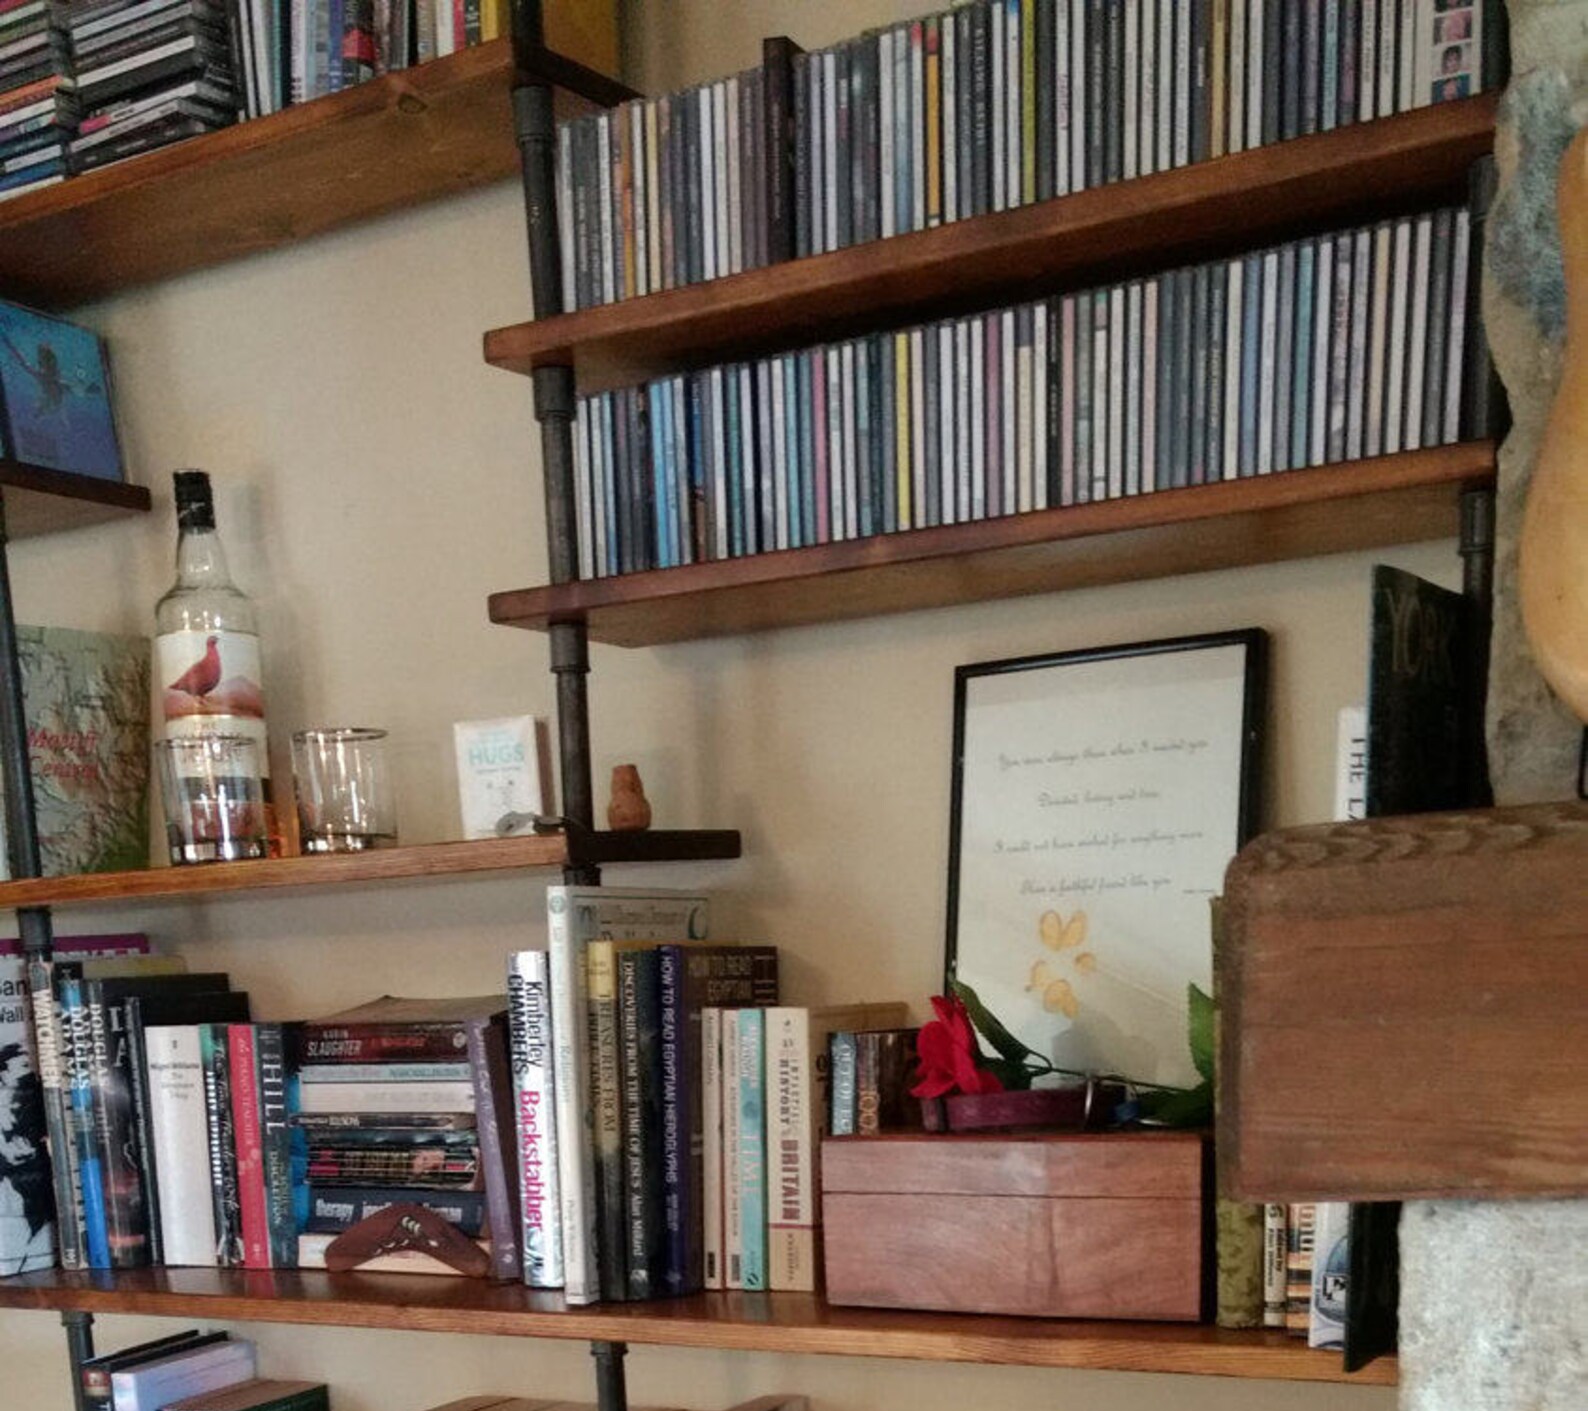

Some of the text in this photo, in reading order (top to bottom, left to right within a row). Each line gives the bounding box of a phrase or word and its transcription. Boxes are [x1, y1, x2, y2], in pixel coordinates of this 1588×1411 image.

[622, 961, 638, 1039] DISCOVERIES
[660, 957, 674, 985] HOW
[662, 988, 675, 1004] TO
[33, 989, 60, 1088] WATCHMEN
[70, 1006, 90, 1089] DOUGLAS
[90, 1003, 109, 1088] DOUGLAS
[308, 1040, 362, 1056] SLAUGHTER
[507, 975, 529, 1084] CHAMBERS
[524, 981, 546, 1068] Kimberley
[663, 1008, 676, 1040] READ
[626, 1042, 639, 1076] FROM
[663, 1043, 677, 1101] EGYPTIAN
[262, 1062, 286, 1136] HILL
[627, 1079, 640, 1104] THE
[628, 1107, 641, 1135] TIME
[779, 1059, 791, 1125] HISTORY
[520, 1090, 544, 1231] Backstabber
[630, 1138, 642, 1153] OF
[630, 1156, 643, 1188] JESUS
[664, 1104, 678, 1183] HIEROGLYPHS
[315, 1198, 354, 1221] therapy
[781, 1139, 800, 1221] BRITAIN
